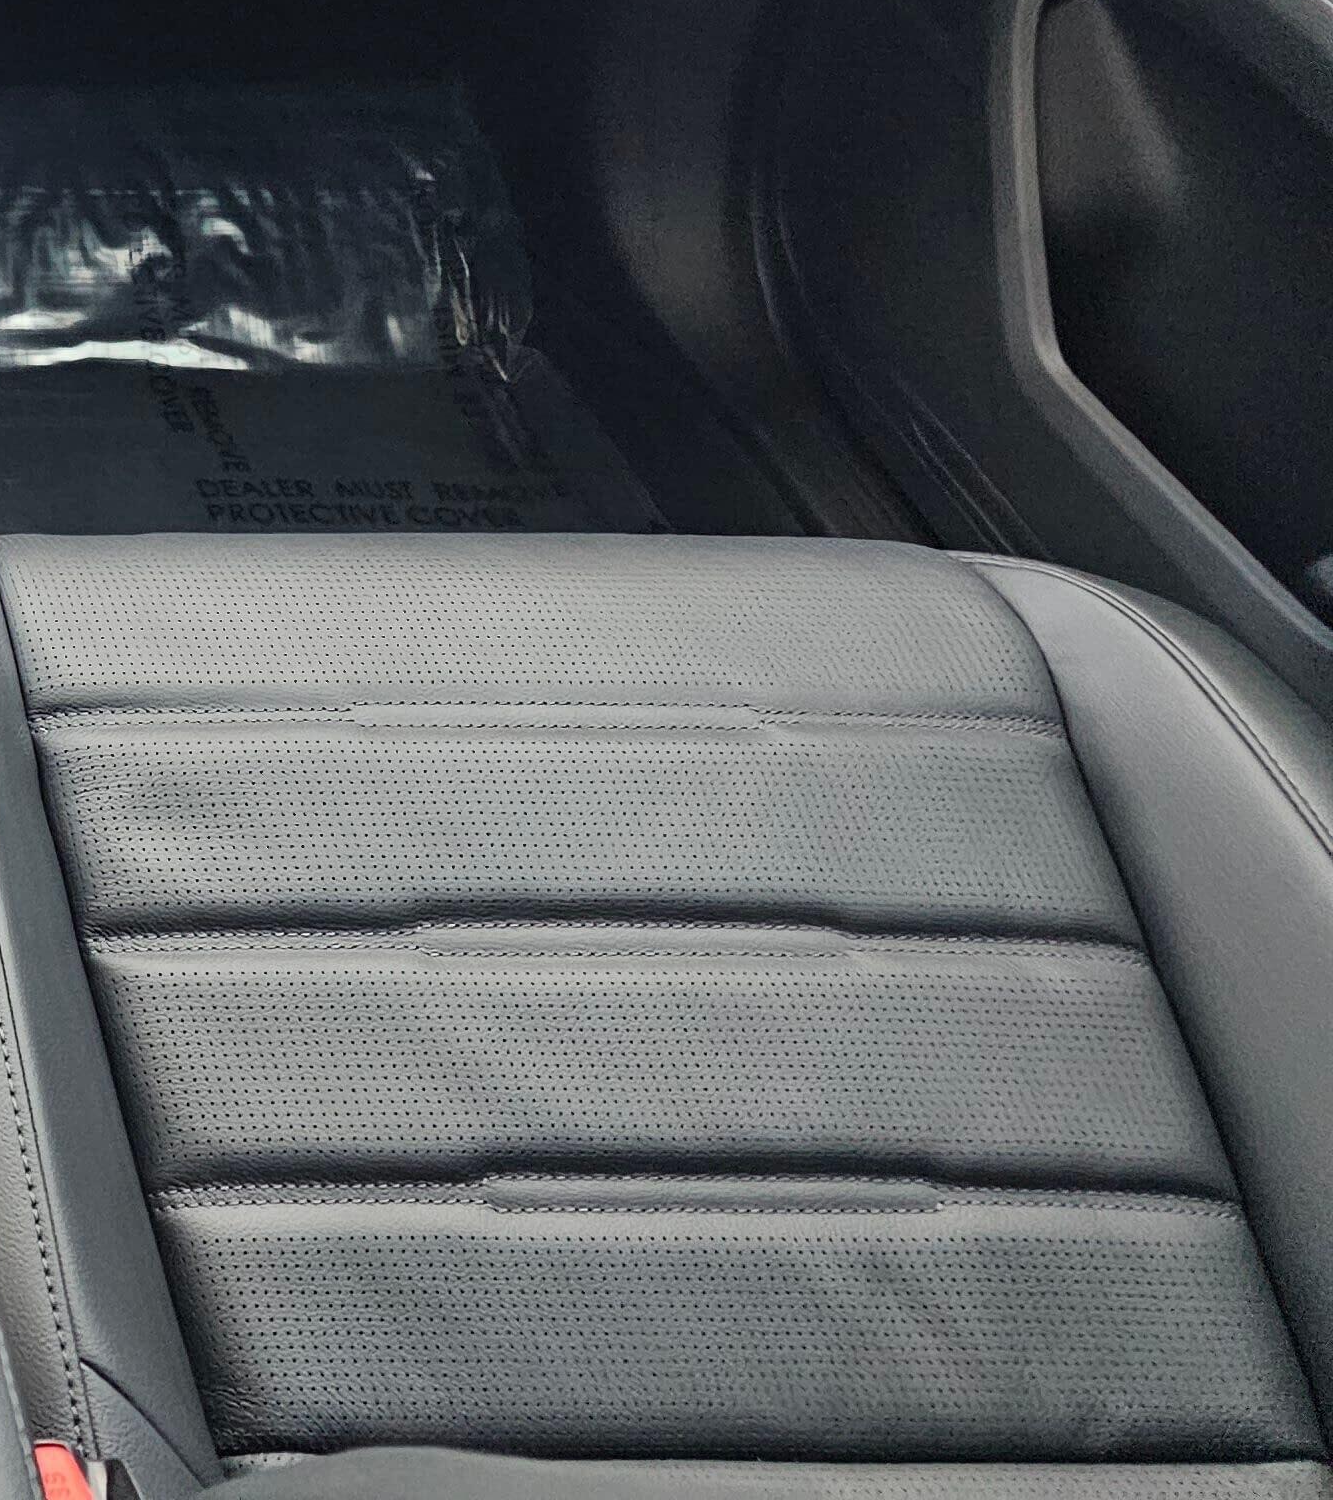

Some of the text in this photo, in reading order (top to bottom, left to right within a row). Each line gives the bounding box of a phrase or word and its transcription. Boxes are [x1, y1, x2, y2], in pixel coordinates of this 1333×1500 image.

[194, 478, 415, 500] DEALER MUST
[206, 502, 398, 528] PROTECTIVE
